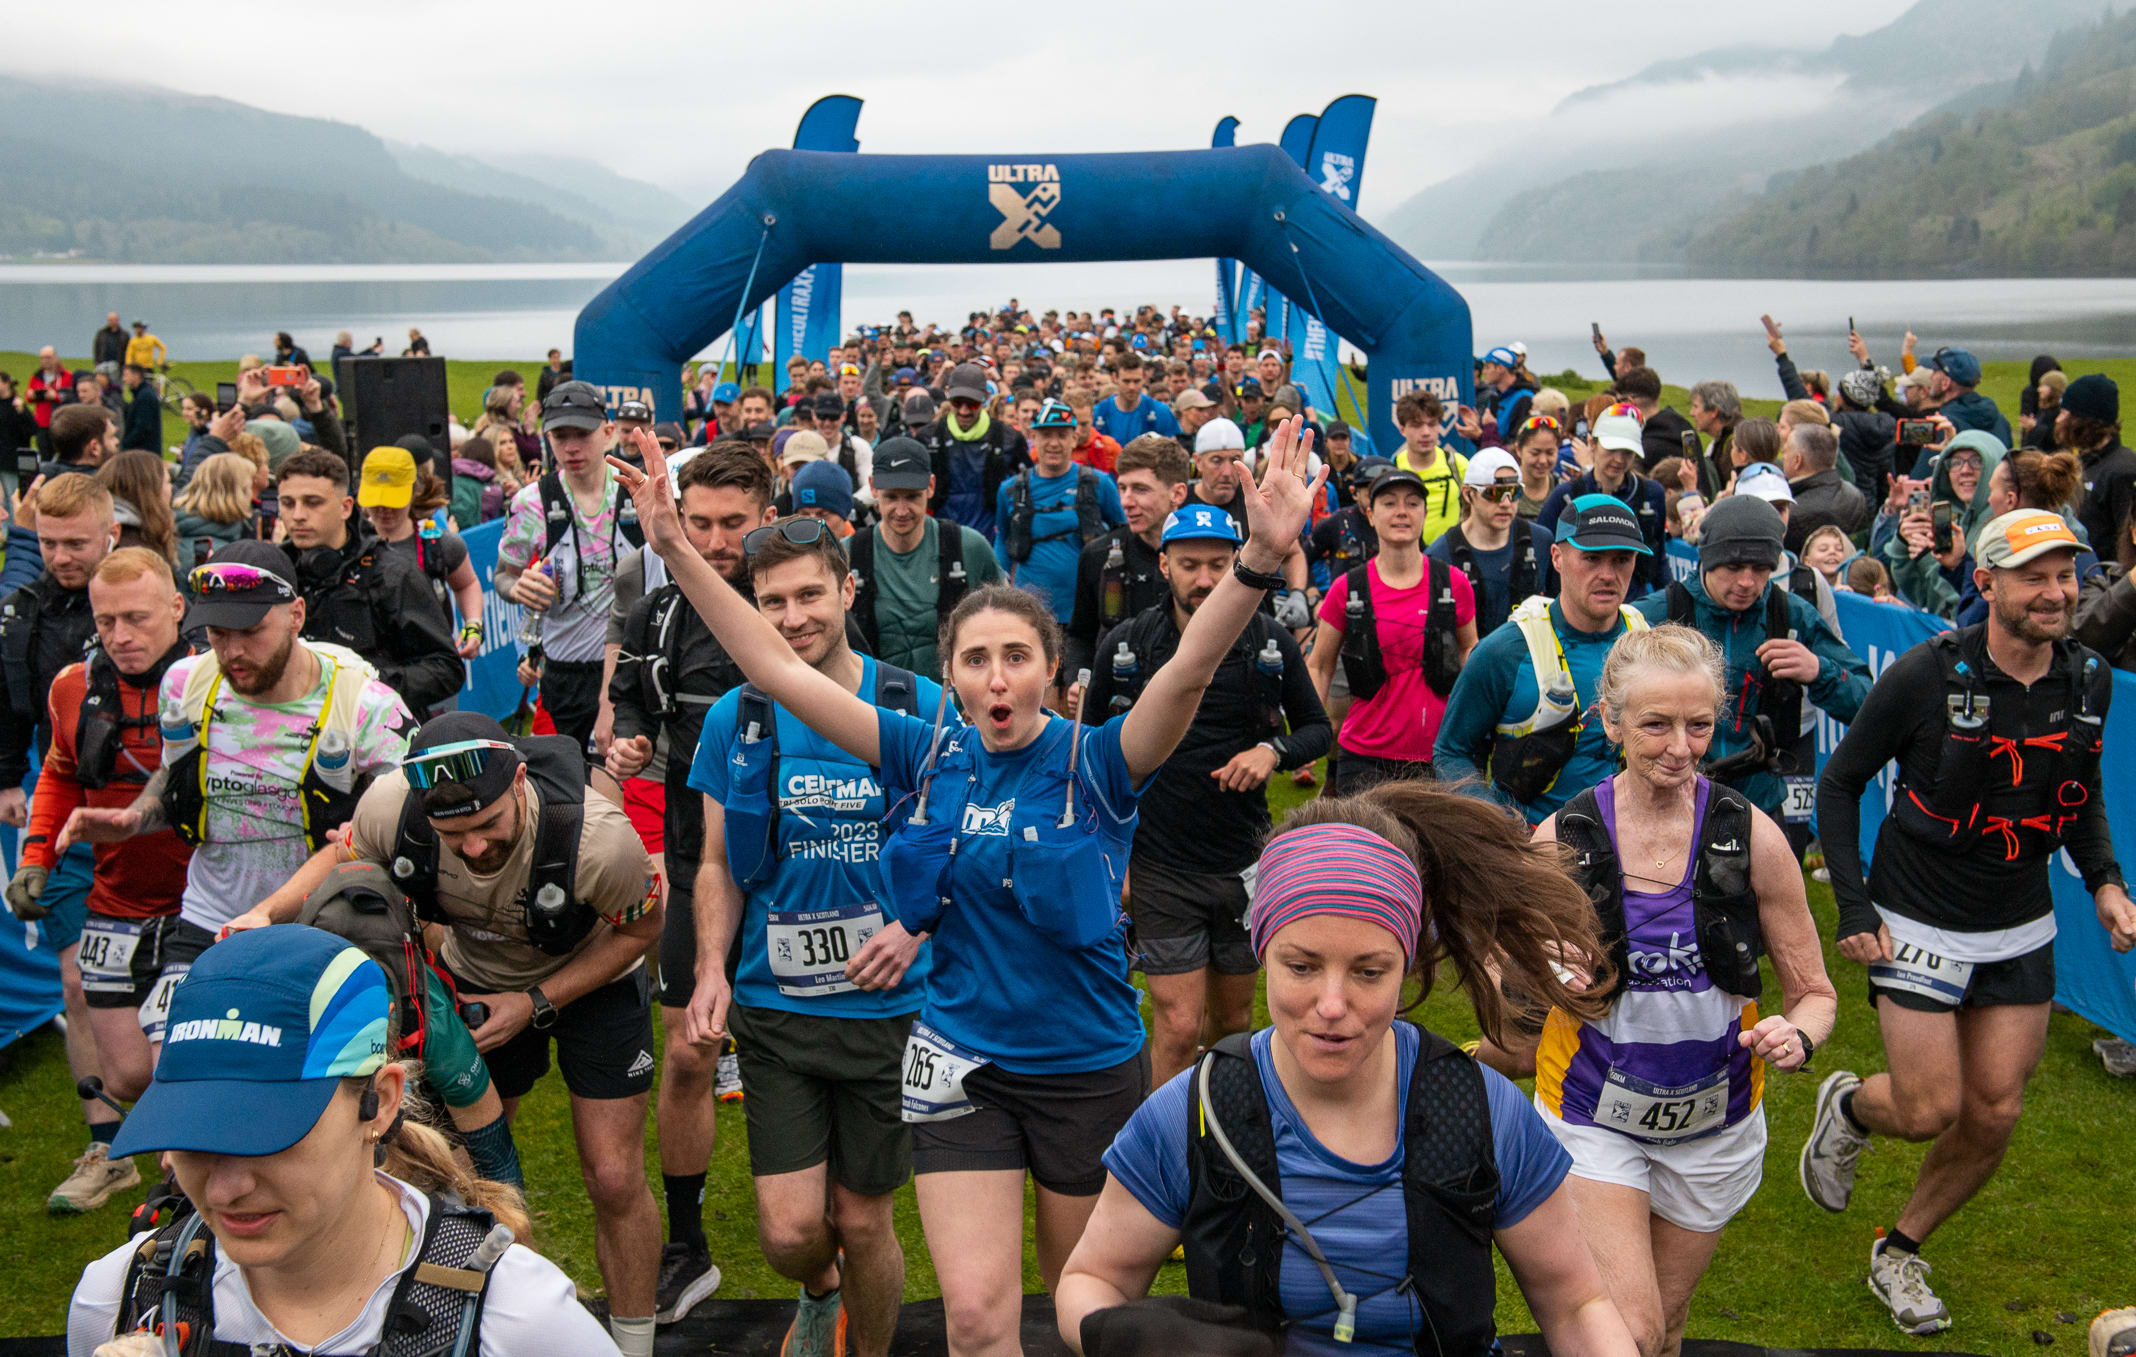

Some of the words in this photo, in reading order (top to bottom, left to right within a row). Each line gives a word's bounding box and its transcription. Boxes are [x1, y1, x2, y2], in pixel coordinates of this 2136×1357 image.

[988, 163, 1060, 182] ULTRA
[593, 385, 656, 411] LTRA
[1391, 376, 1459, 402] ULTRA
[1589, 515, 1636, 529] SALOMON
[840, 801, 863, 809] FIVE
[831, 821, 879, 842] 2023
[789, 840, 880, 864] FINISHER
[80, 934, 111, 967] 443
[798, 926, 850, 966] 330
[168, 1008, 283, 1047] IRONMAN
[905, 1043, 943, 1090] 265
[1639, 1099, 1697, 1132] 452
